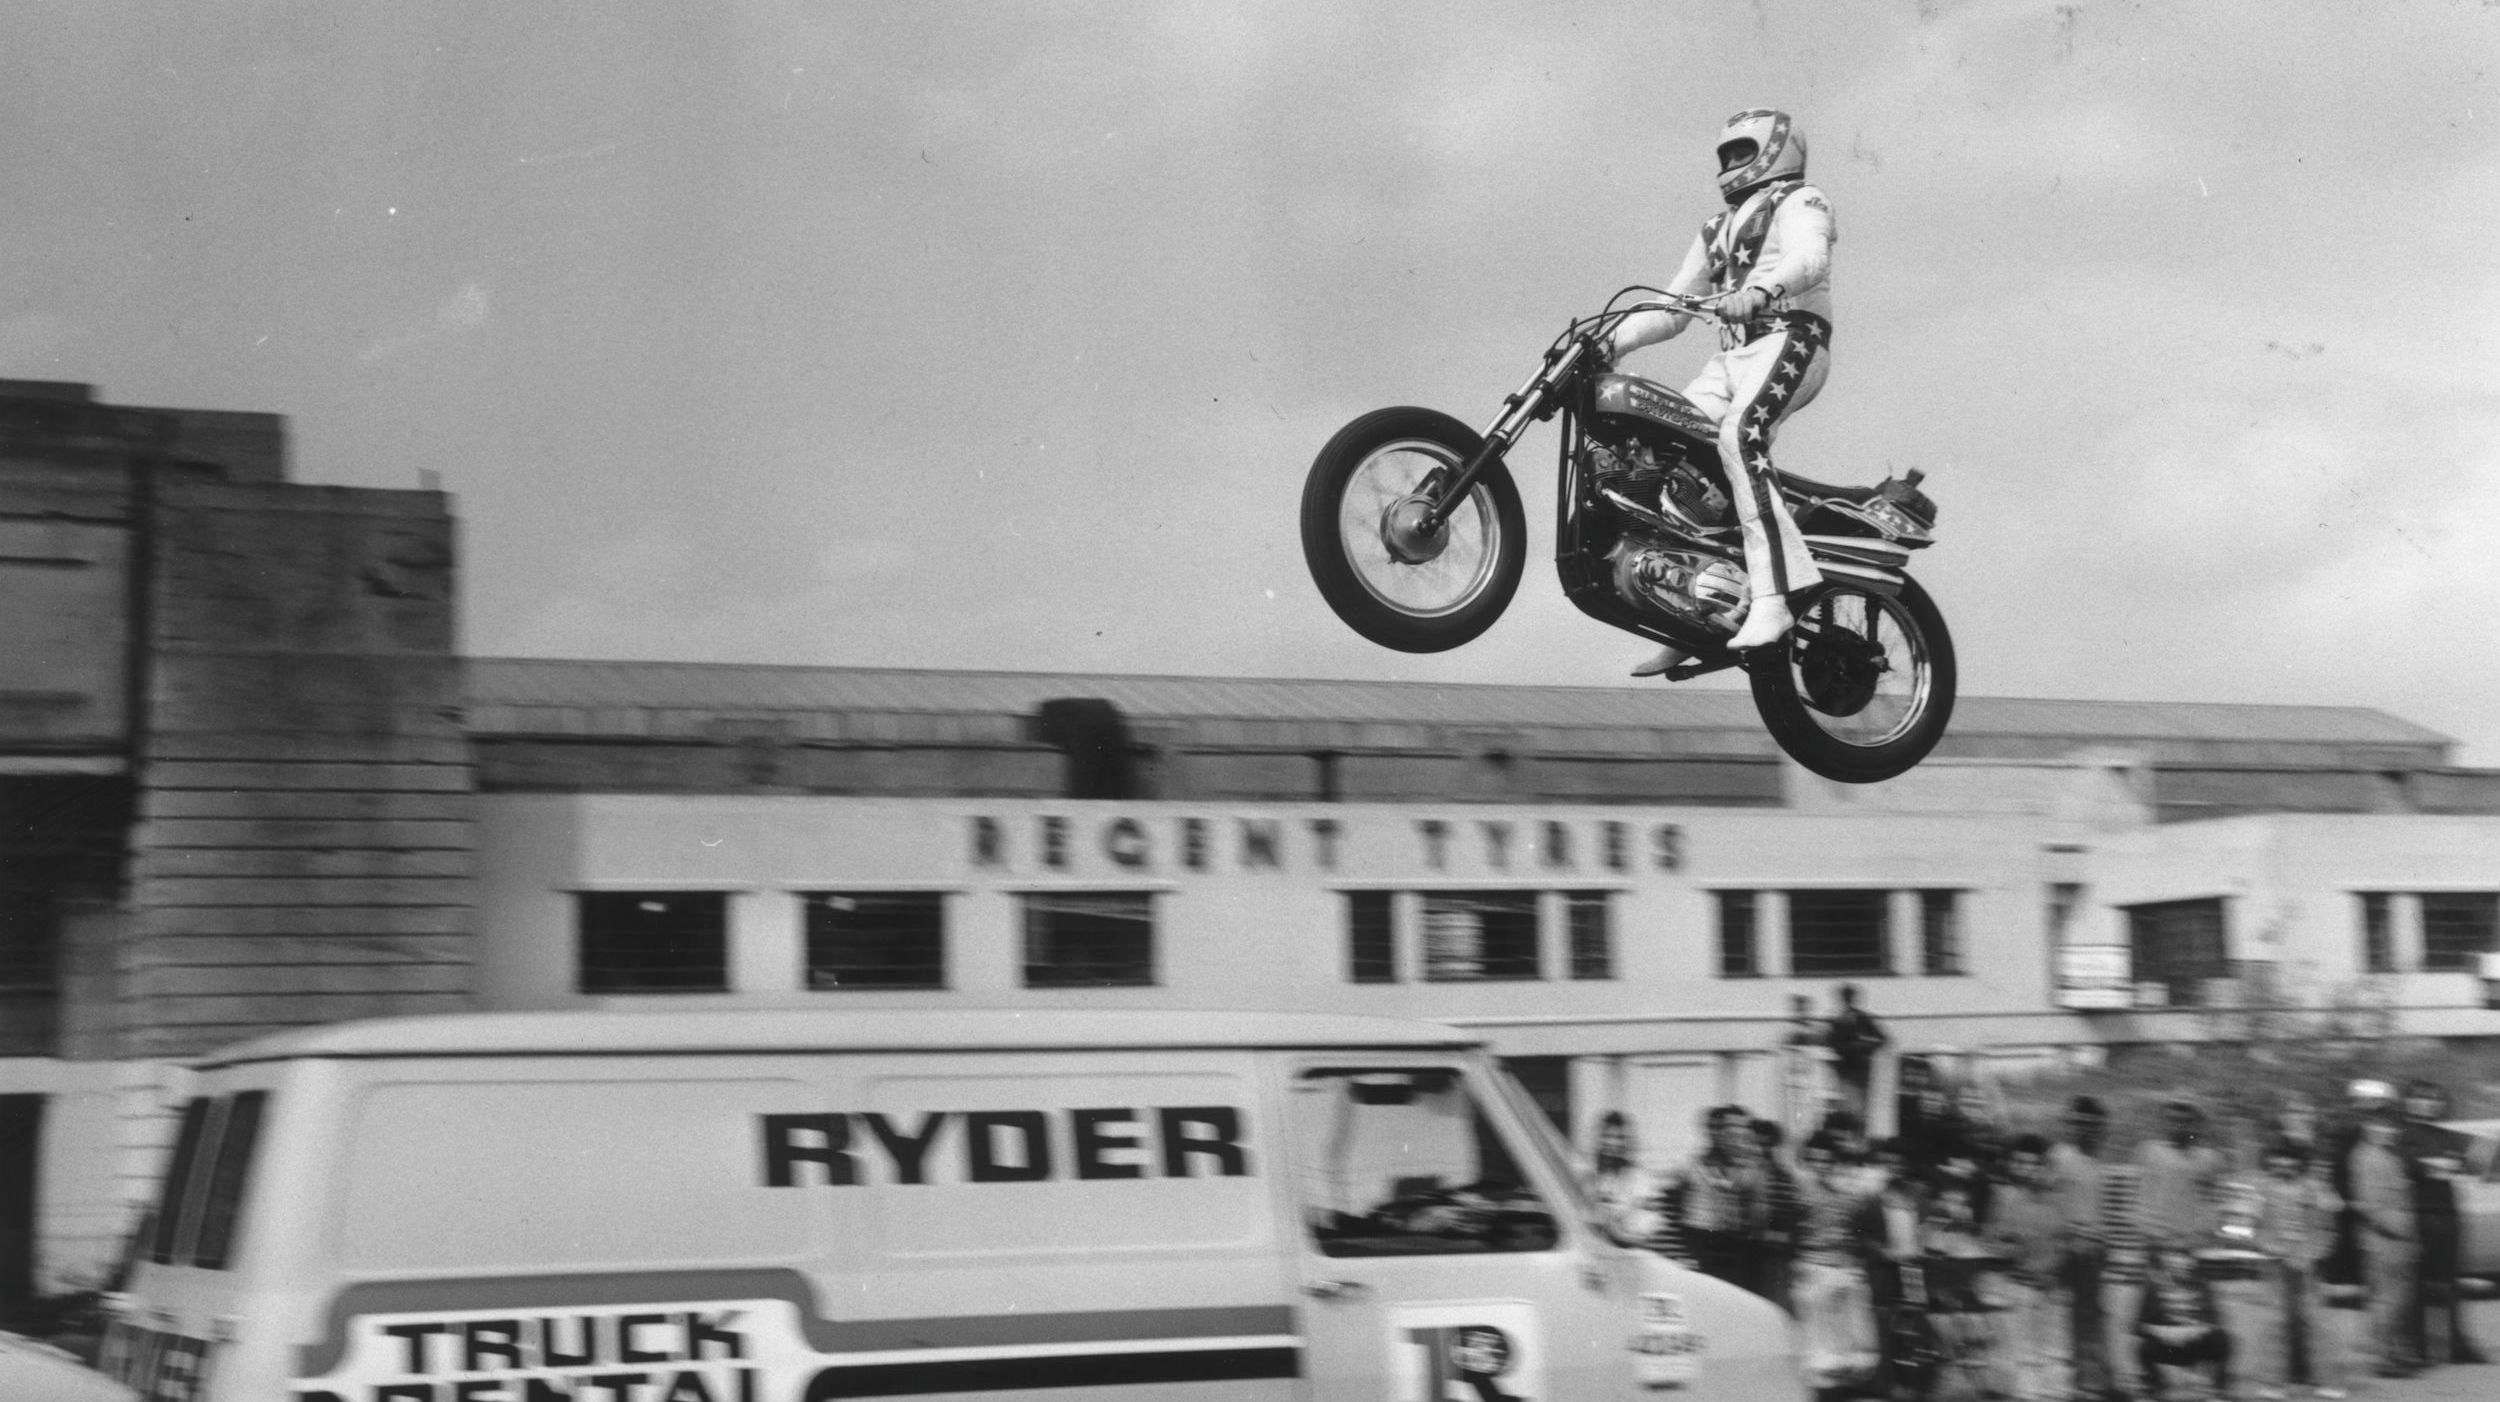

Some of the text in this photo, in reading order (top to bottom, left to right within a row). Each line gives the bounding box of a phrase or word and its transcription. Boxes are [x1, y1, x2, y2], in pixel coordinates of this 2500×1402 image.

[968, 814, 1686, 874] REGENT TYRES
[754, 1106, 1254, 1187] RYDER
[380, 1312, 744, 1374] TRUCK
